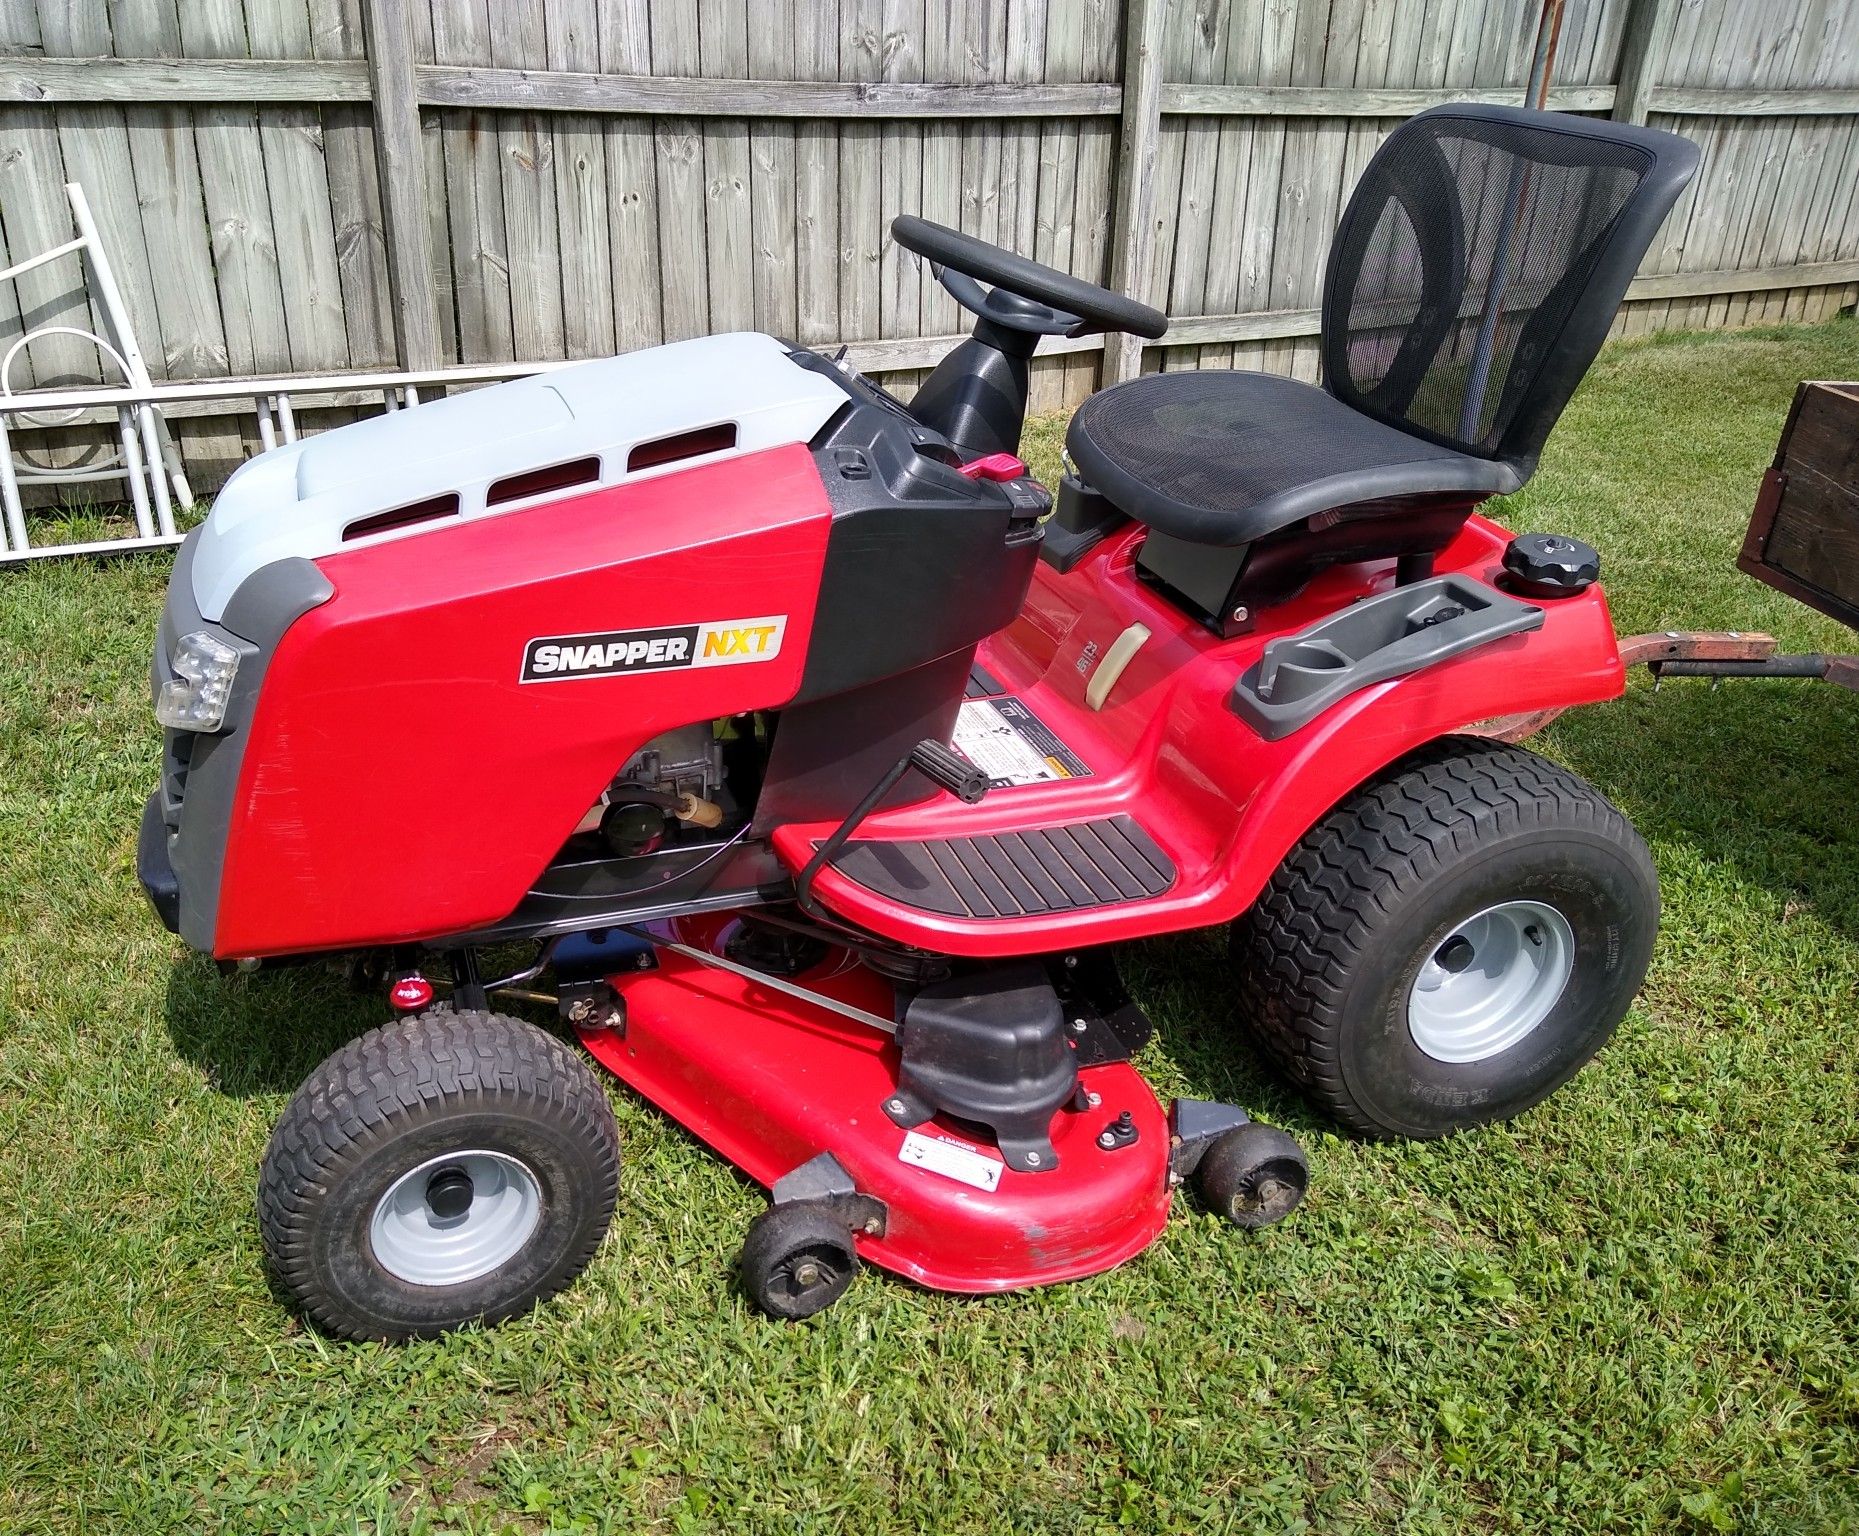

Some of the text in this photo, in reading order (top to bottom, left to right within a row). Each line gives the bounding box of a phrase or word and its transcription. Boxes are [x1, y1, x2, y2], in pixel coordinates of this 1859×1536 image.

[532, 625, 777, 674] SNAPPER NXT
[945, 1136, 977, 1153] DANGER
